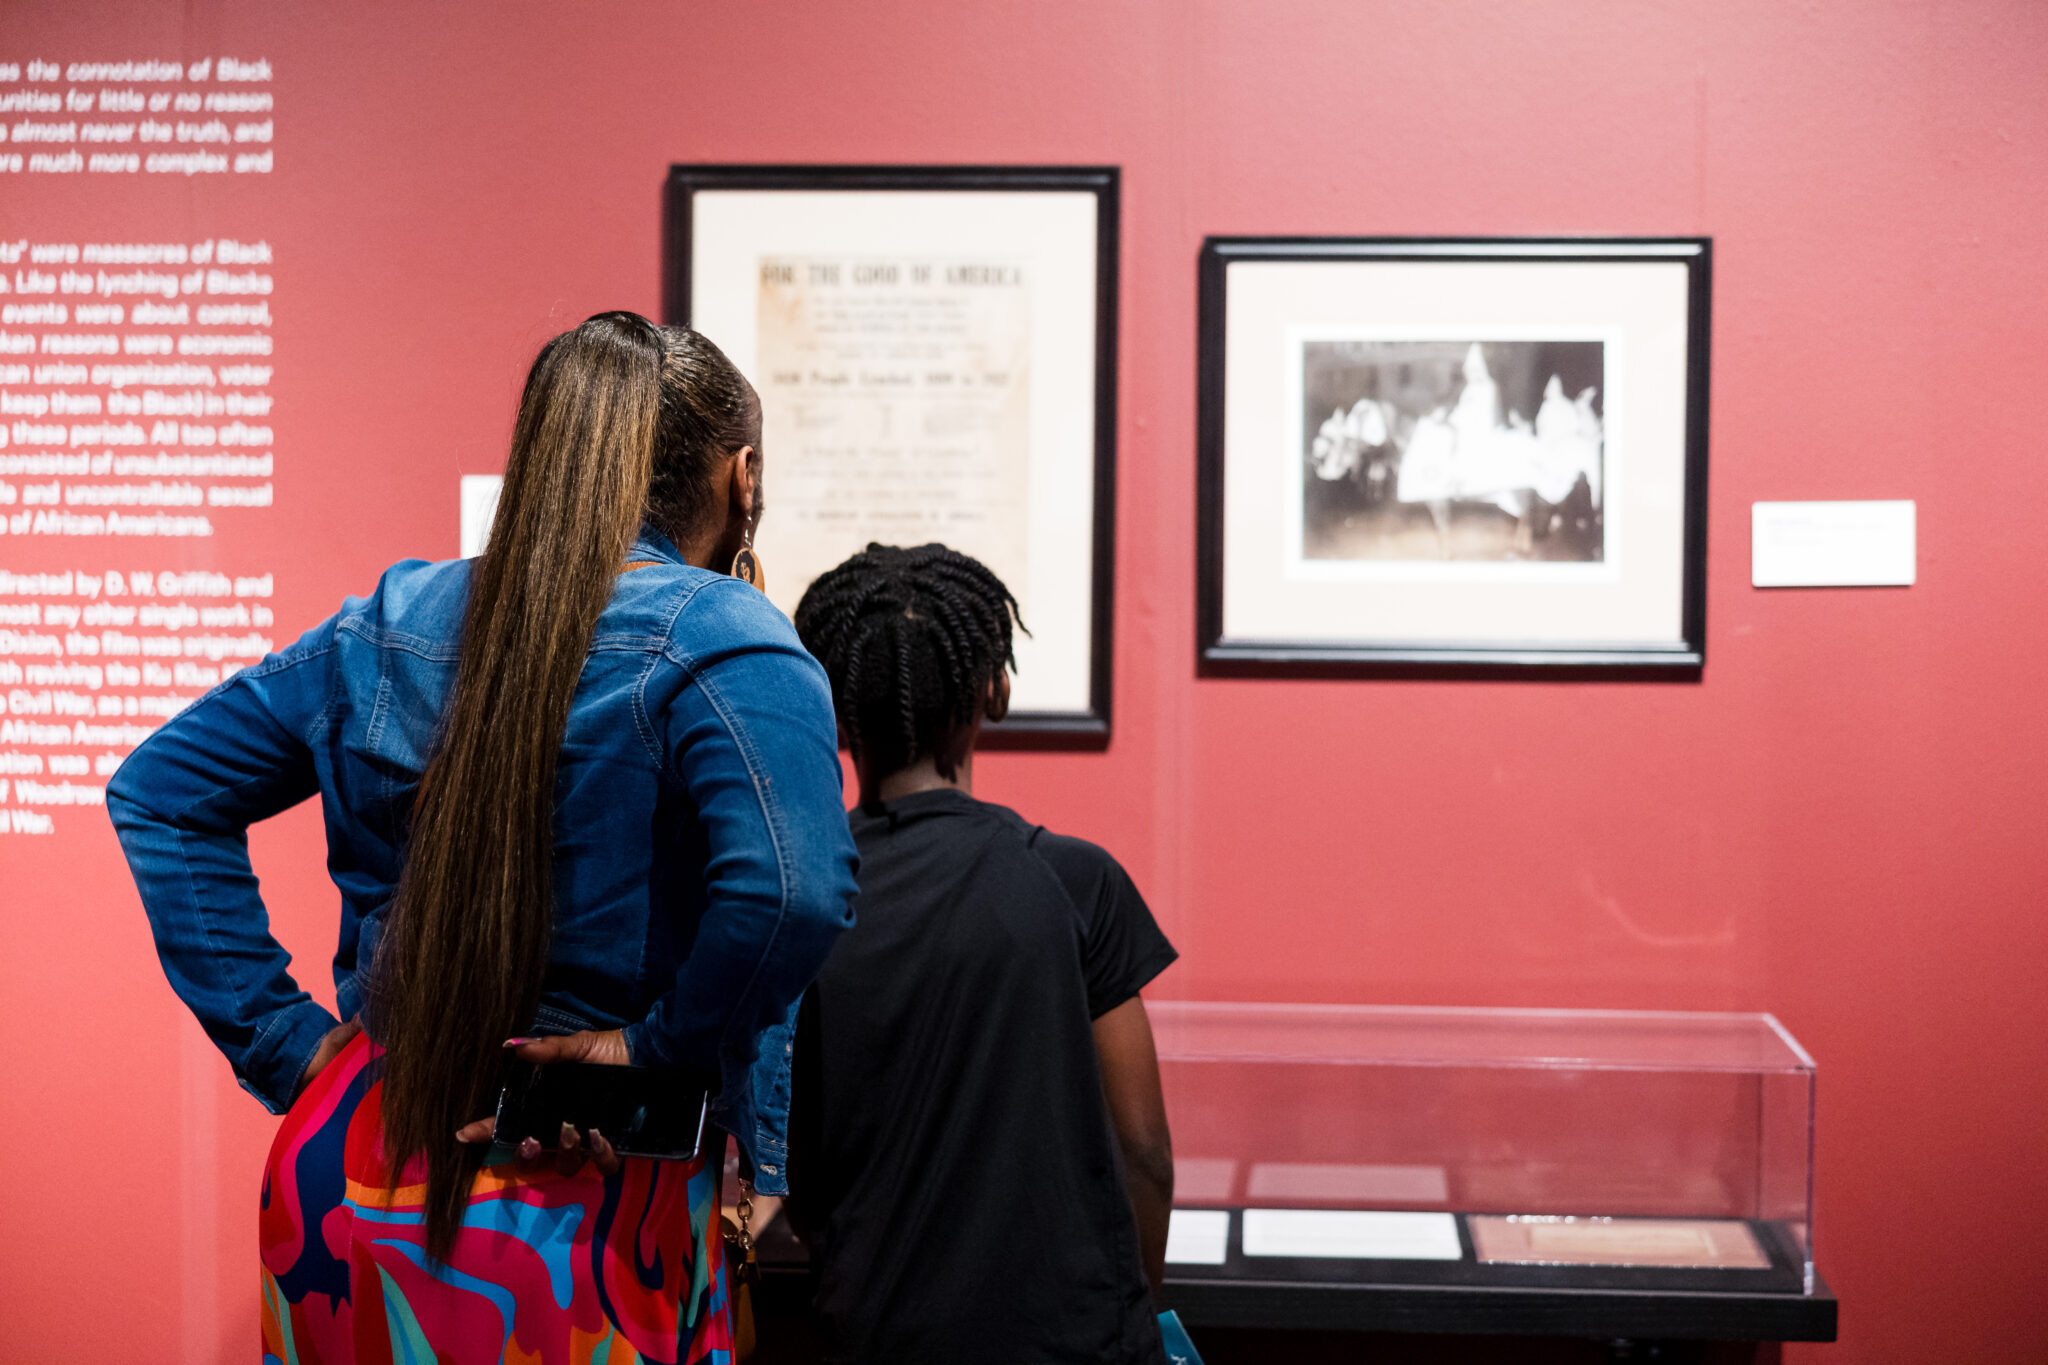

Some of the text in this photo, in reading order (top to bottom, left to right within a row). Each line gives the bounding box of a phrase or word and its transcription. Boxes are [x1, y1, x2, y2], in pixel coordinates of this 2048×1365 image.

[27, 58, 60, 82] the
[66, 59, 183, 82] connotation
[188, 56, 211, 82] of
[217, 57, 273, 82] Black
[66, 87, 95, 112] for
[99, 88, 145, 112] little
[149, 93, 171, 112] or
[174, 93, 202, 112] no
[205, 93, 273, 112] reason
[11, 118, 76, 142] almost
[81, 123, 136, 142] never
[139, 118, 173, 142] the
[176, 119, 231, 144] truth,
[234, 118, 273, 142] and
[29, 148, 83, 173] much
[88, 153, 140, 173] more
[145, 149, 228, 176] complex
[234, 149, 273, 173] and
[31, 243, 79, 264] were
[82, 243, 188, 264] massacres
[190, 239, 214, 264] of
[216, 239, 273, 264] Black
[15, 268, 57, 294] Like
[60, 269, 94, 294] the
[97, 269, 179, 298] lynching
[180, 269, 204, 294] of
[206, 269, 273, 295] Blacks
[2, 299, 273, 327] events were about control,
[41, 333, 119, 355] reasons
[123, 334, 173, 355] were
[177, 331, 273, 356] economic
[33, 360, 88, 385] union
[218, 363, 273, 386] voter
[107, 390, 142, 416] the
[225, 391, 273, 416] their
[12, 420, 68, 445] these
[150, 420, 179, 446] All
[181, 425, 217, 446] too
[218, 420, 273, 446] often
[91, 449, 114, 476] of
[22, 480, 60, 505] and
[65, 480, 204, 507] uncontrollable
[207, 482, 273, 507] sexual
[9, 509, 32, 535] of
[32, 509, 105, 536] African
[75, 570, 102, 599] by
[104, 570, 129, 597] D.
[233, 571, 273, 598] and
[44, 604, 81, 629] any
[83, 601, 138, 626] other
[199, 602, 251, 627] work
[252, 602, 273, 627] in
[65, 630, 100, 656] the
[101, 630, 140, 656] film
[140, 636, 182, 656] was
[105, 660, 140, 686] the
[97, 695, 123, 716] as
[124, 696, 139, 716] a
[48, 755, 90, 775] was
